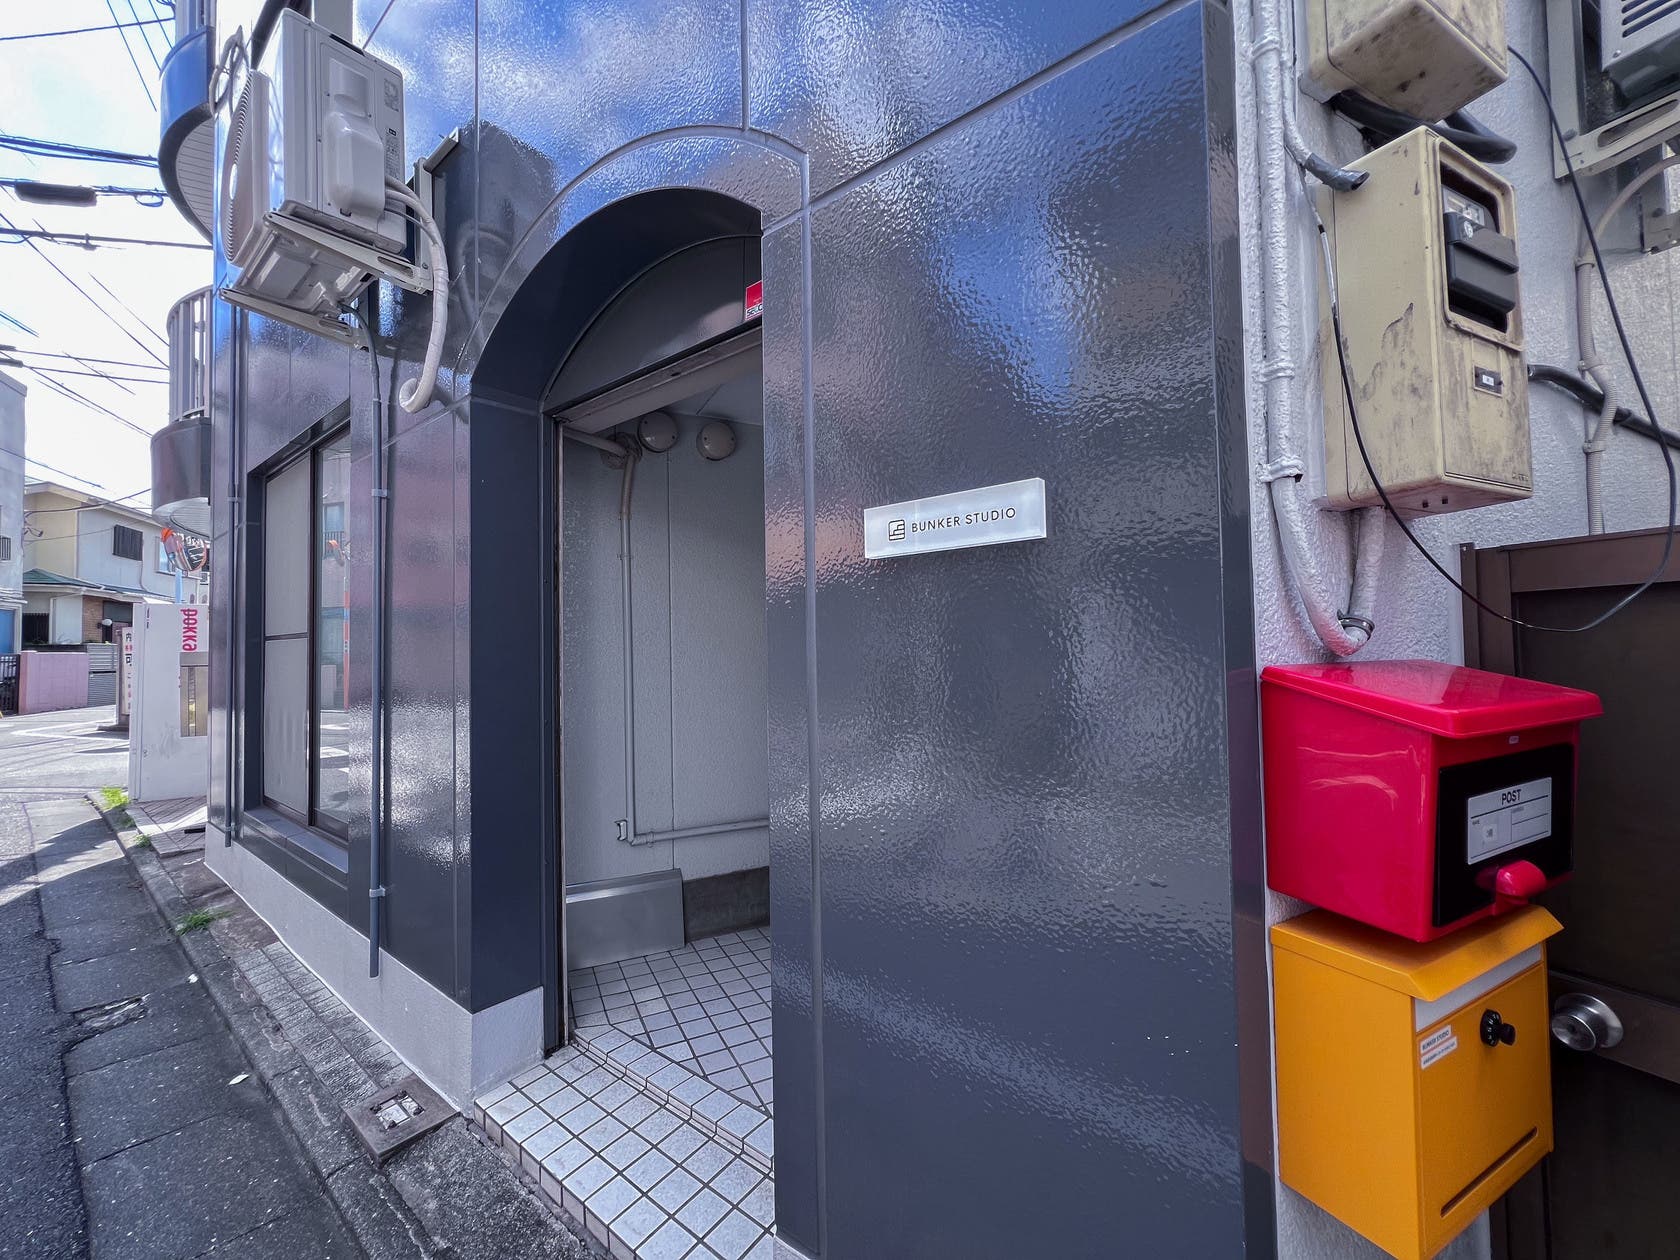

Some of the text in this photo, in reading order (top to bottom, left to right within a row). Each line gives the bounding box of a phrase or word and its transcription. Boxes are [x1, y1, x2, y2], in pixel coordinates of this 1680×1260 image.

[911, 507, 1016, 533] BUNKER STUDIO
[1501, 789, 1522, 805] POST
